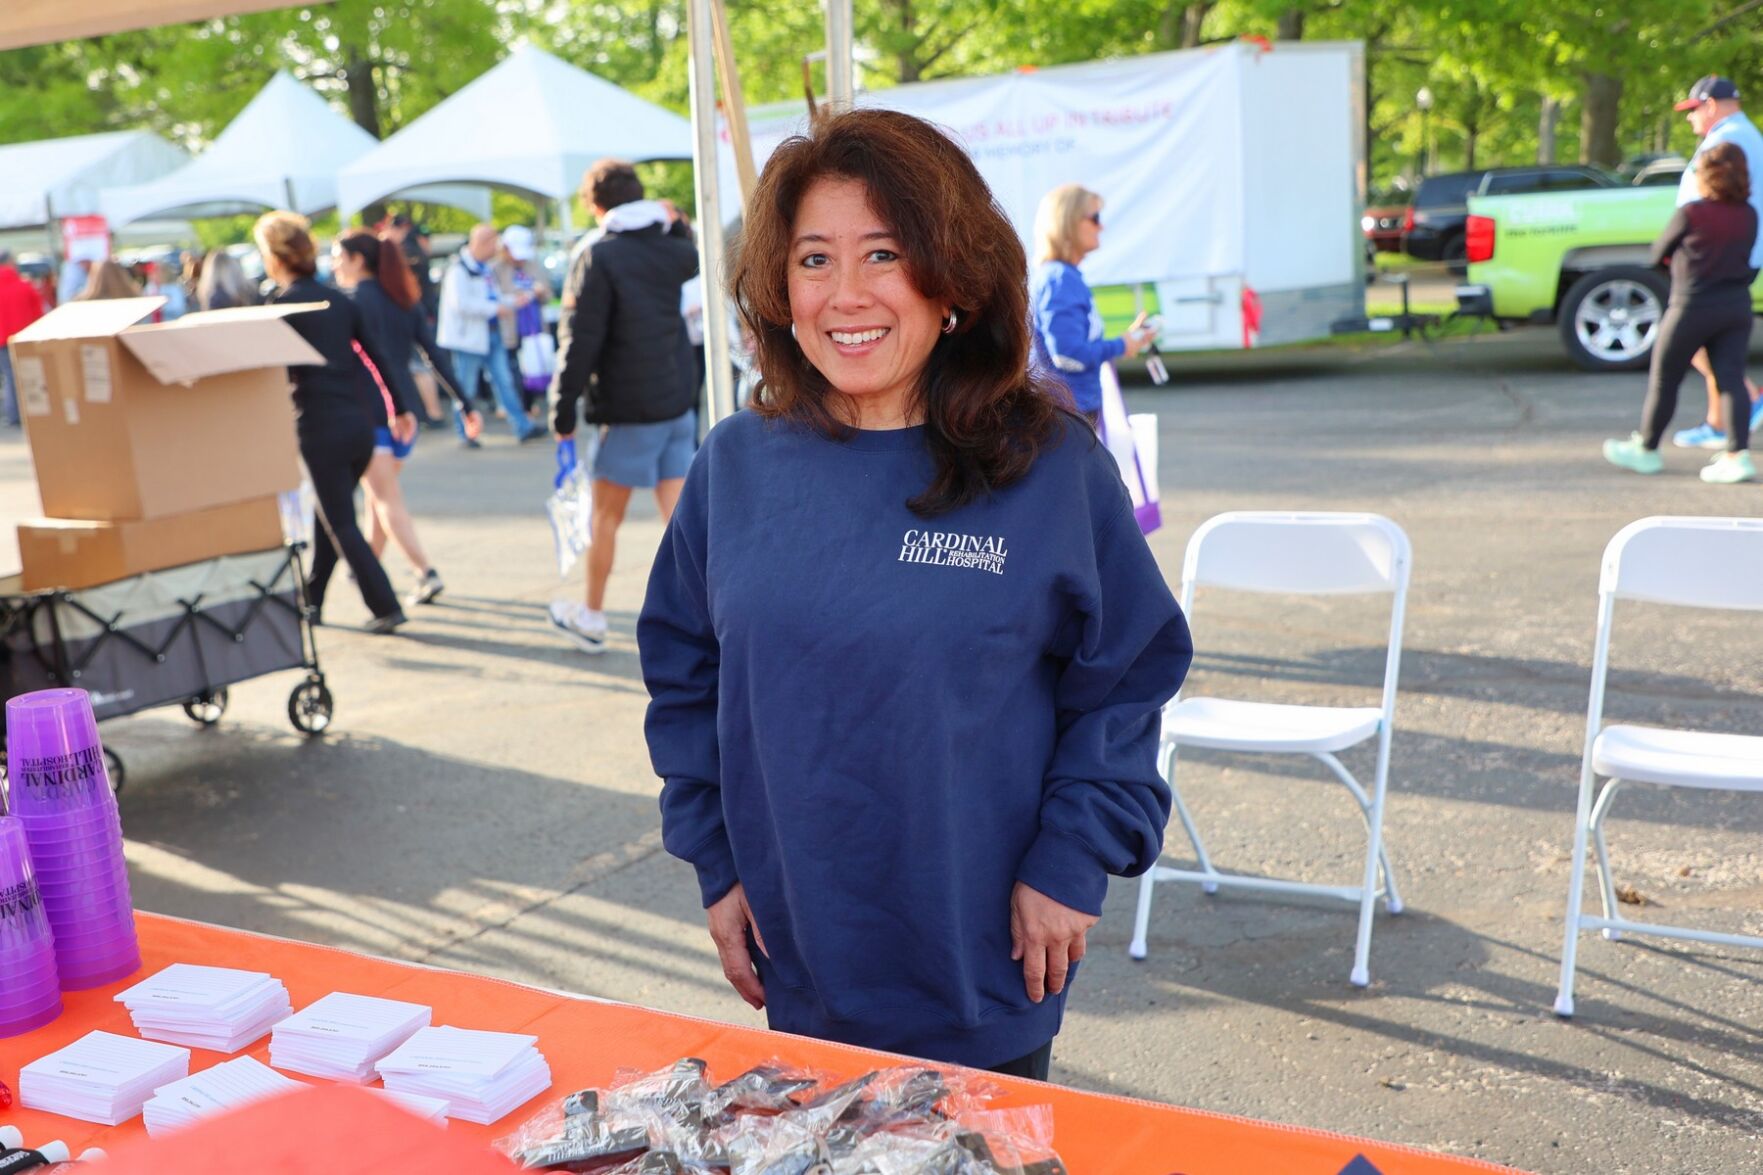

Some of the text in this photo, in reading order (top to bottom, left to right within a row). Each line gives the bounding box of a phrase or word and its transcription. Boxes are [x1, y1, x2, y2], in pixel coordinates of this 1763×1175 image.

[996, 119, 1025, 138] ALL
[1034, 113, 1059, 134] UP
[1091, 101, 1172, 126] TRIBUTE
[903, 529, 1008, 557] CARDINAL
[898, 545, 1006, 566] HILL REHABILITATION
[945, 556, 1004, 575] HOSPITAL
[20, 754, 69, 768] HOSPITAL
[68, 745, 100, 767] HILL
[21, 758, 102, 788] CARDINAL
